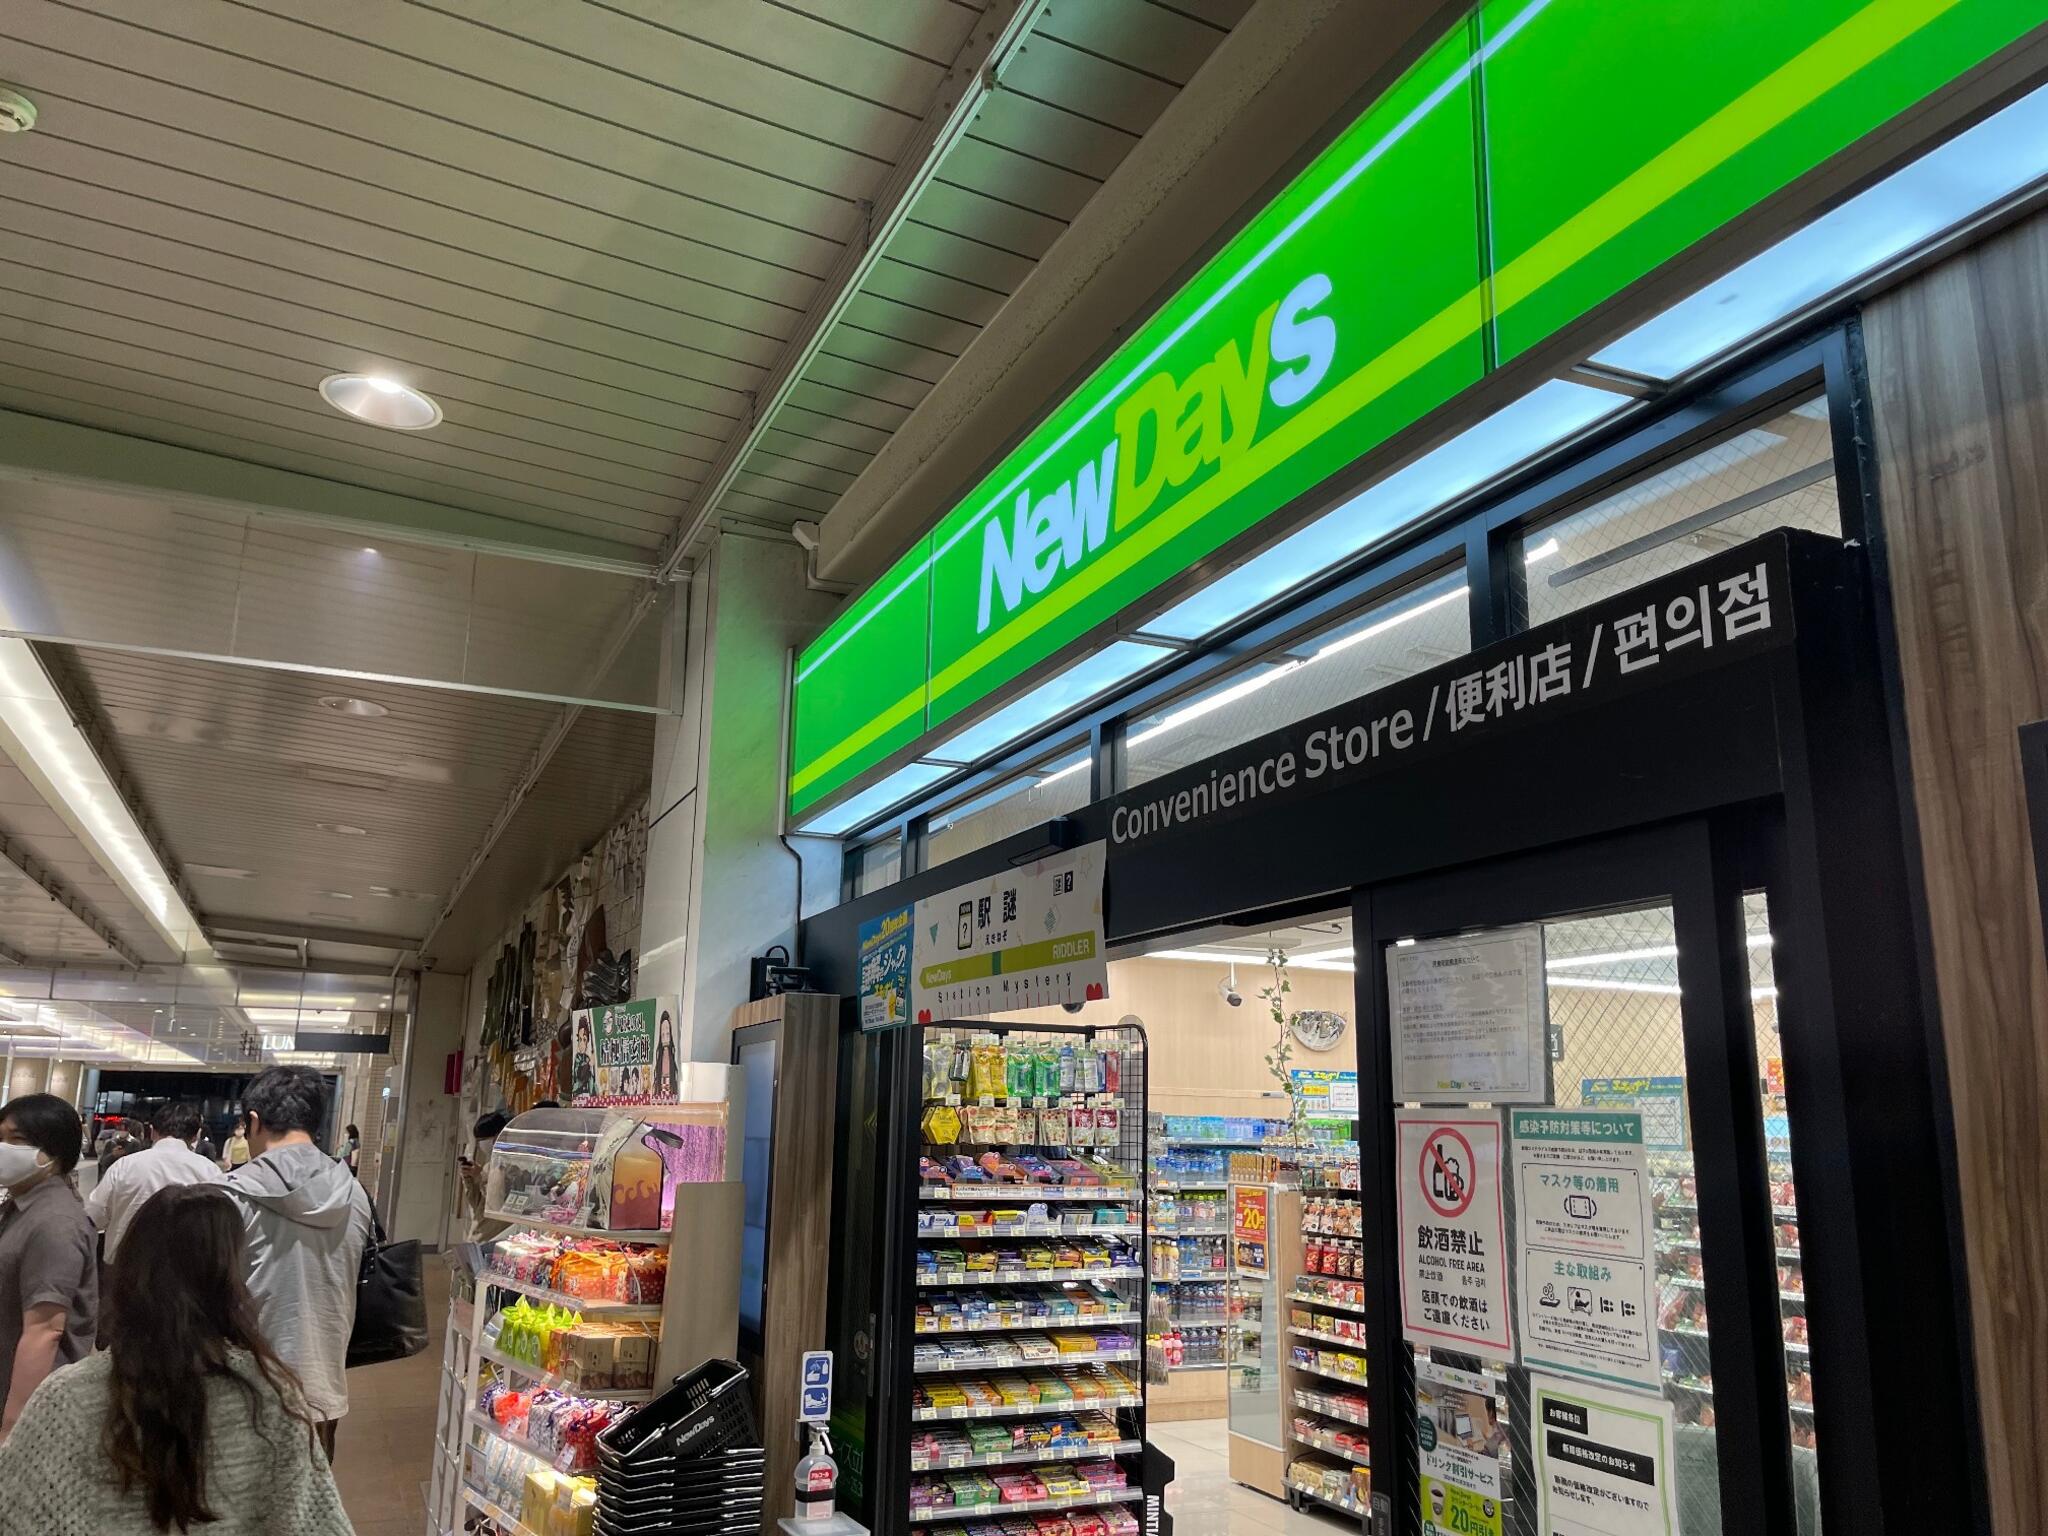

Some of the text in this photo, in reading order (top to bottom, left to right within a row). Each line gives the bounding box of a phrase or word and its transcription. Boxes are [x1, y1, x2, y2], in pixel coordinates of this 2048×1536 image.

[977, 273, 1336, 634] NewDays
[1112, 752, 1296, 844] Convenience
[1304, 709, 1415, 779] Store
[1444, 642, 1572, 733] 便利店
[1611, 562, 1770, 675] 편의점
[1052, 938, 1090, 959] RIDDLER
[1003, 971, 1073, 994] Mystery
[1519, 1119, 1635, 1137] 感染予防対策等について
[1539, 1173, 1620, 1193] マスク等の着用
[1417, 1224, 1485, 1257] 飲酒禁止
[1418, 1254, 1486, 1273] ALCOHOL FREE AREA
[1553, 1259, 1612, 1283] 主な取組み
[1421, 1289, 1488, 1314] 店頭での飲酒は
[1423, 1307, 1490, 1332] ご遠慮ください
[676, 1415, 715, 1447] NewDays
[1426, 1453, 1495, 1487] ドリンク割引サービス
